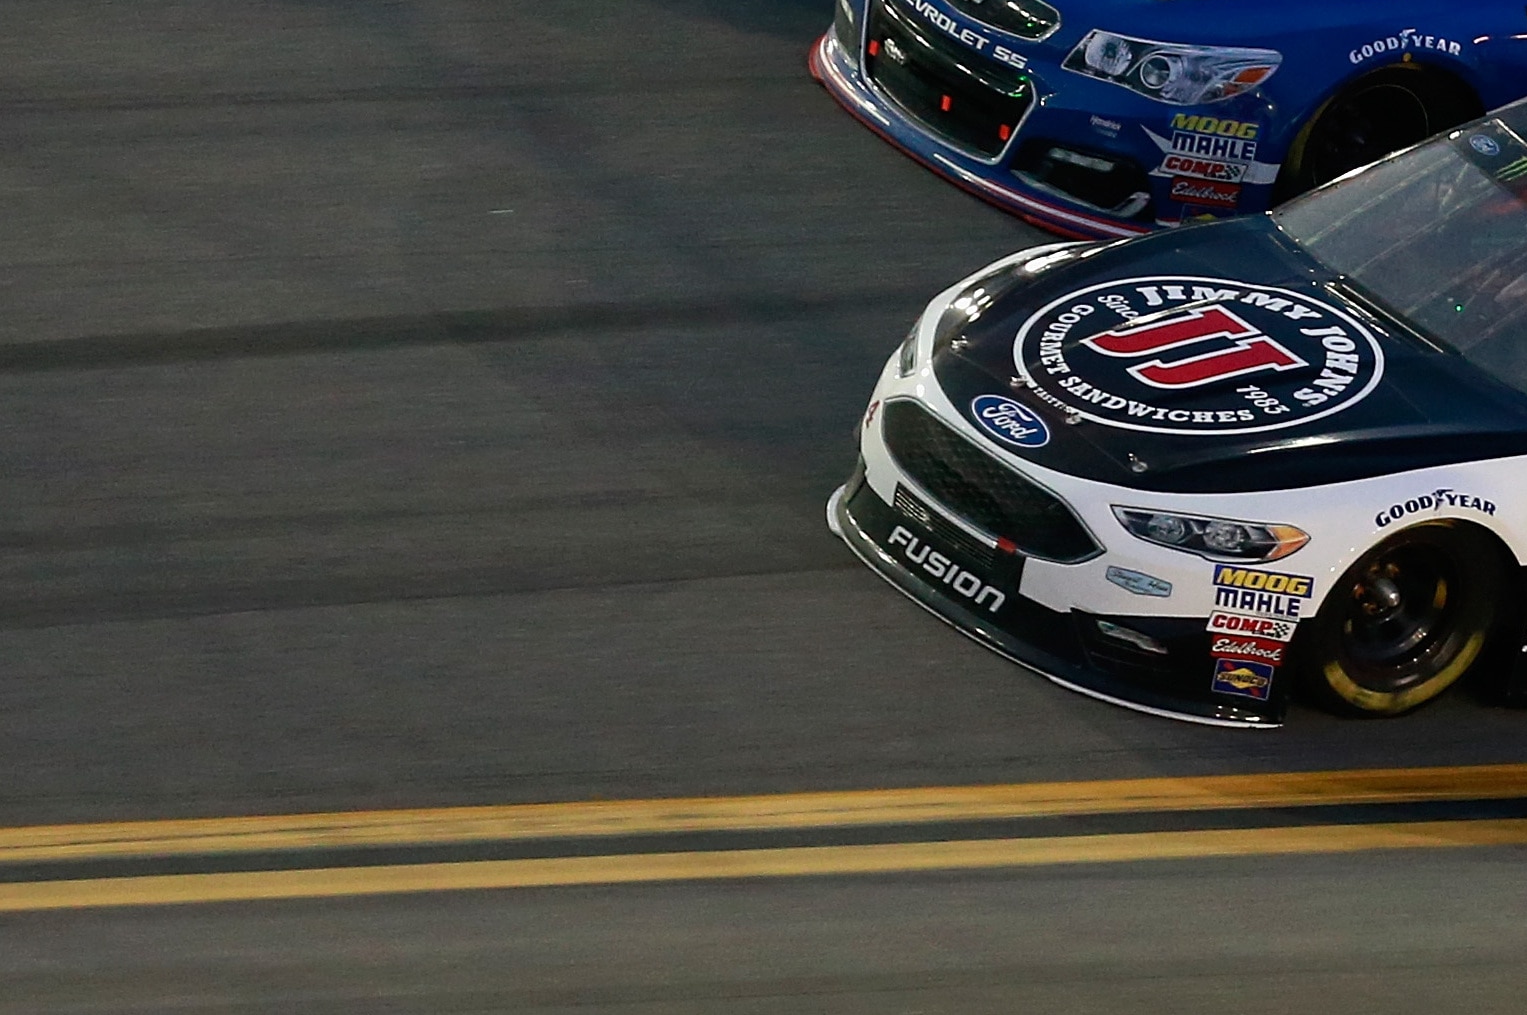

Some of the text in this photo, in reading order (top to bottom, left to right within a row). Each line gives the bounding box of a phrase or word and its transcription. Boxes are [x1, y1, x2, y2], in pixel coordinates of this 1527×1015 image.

[993, 45, 1029, 70] SS
[1350, 29, 1461, 64] GOODYEAR
[1170, 113, 1259, 139] MOOG
[1172, 131, 1256, 160] MAHLE
[1165, 156, 1225, 174] COMP
[1172, 182, 1237, 203] Edelbrock
[1078, 303, 1310, 389] JJ
[1135, 285, 1361, 407] JIMMY JOHN'S
[1038, 303, 1255, 424] GOURMET SANDWICHES
[1235, 384, 1291, 416] 1983
[982, 403, 1038, 440] Ford
[1375, 488, 1496, 527] GOODYEAR
[888, 526, 1006, 613] FUSION
[1217, 568, 1310, 596] MOOG
[1215, 588, 1300, 617] MAHLE
[1212, 614, 1273, 634] COMP
[1212, 639, 1281, 661] Edelbrock
[1218, 671, 1268, 687] SUNOCO
